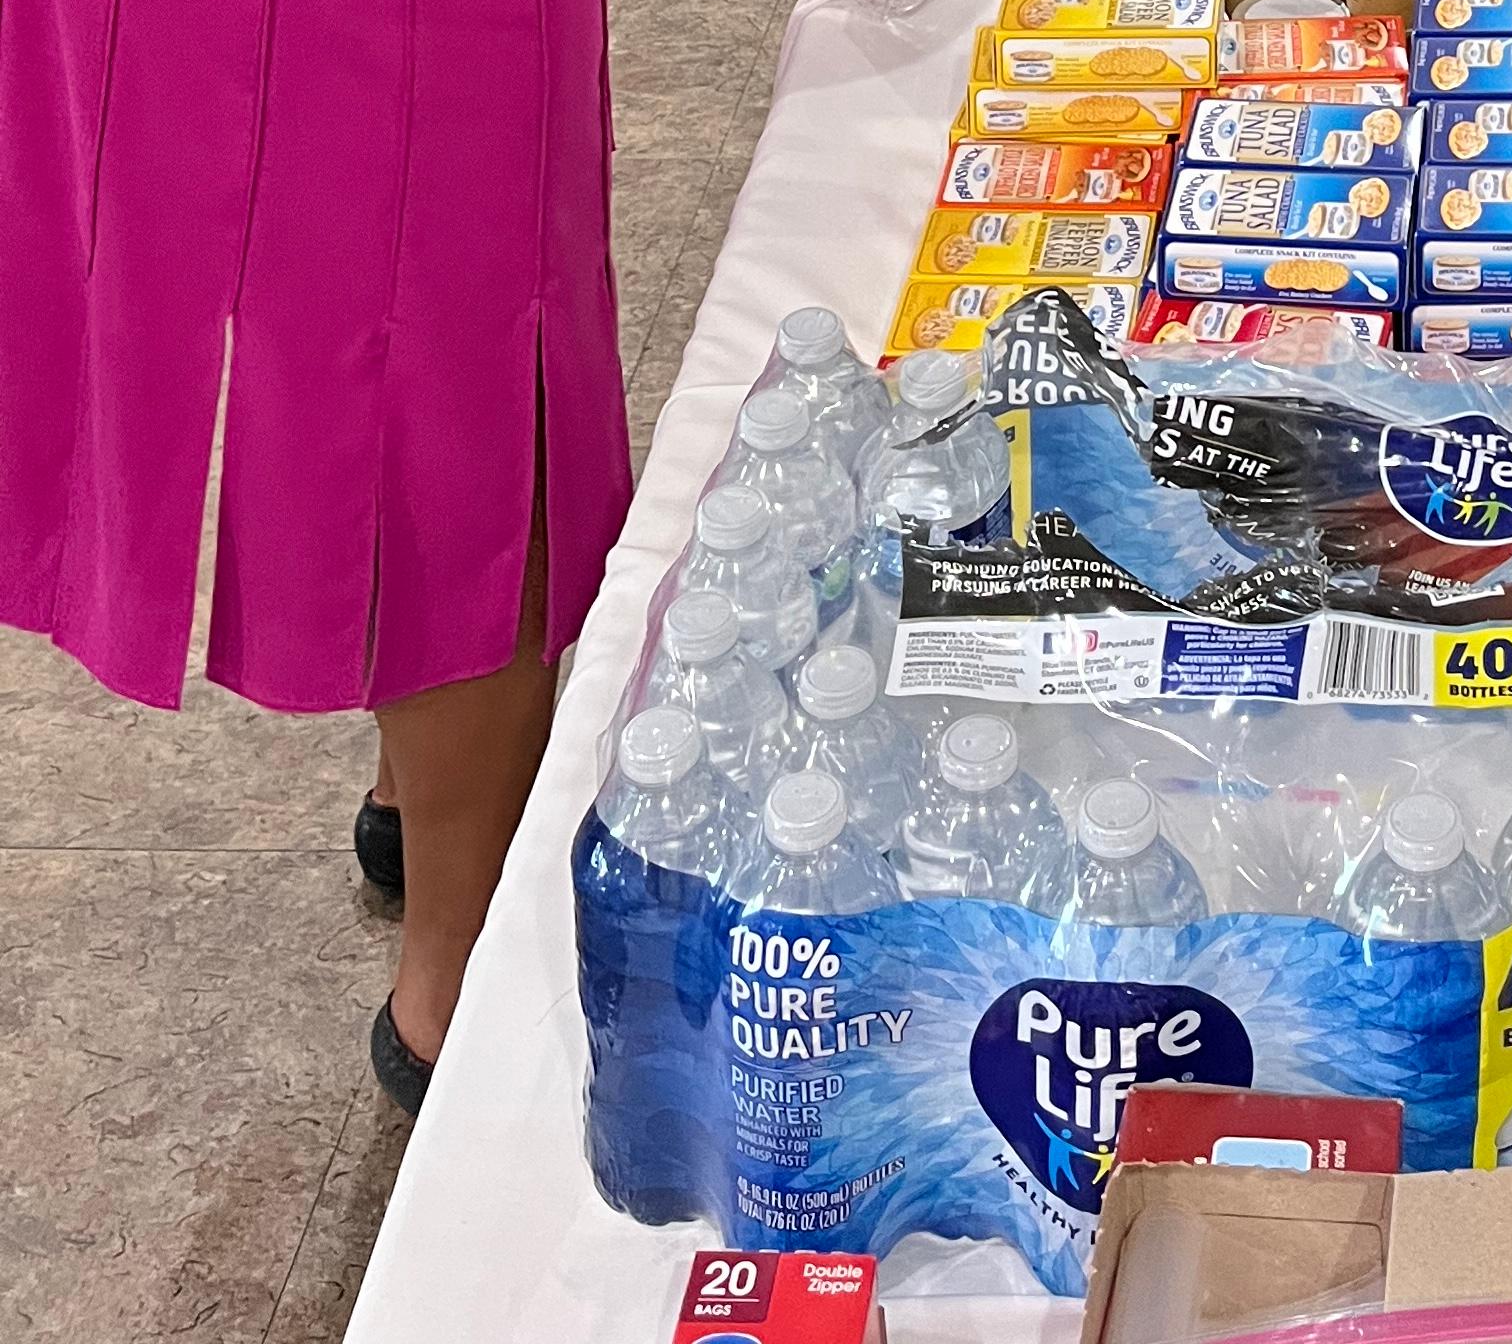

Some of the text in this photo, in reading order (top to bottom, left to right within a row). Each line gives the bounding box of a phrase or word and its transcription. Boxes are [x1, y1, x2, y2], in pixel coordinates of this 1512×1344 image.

[1199, 103, 1232, 158] BRUNSWICK
[1237, 109, 1270, 153] TUNA
[1265, 108, 1296, 158] SALAD
[954, 147, 986, 200] BRUNSWICK
[1178, 173, 1214, 231] BRUNSWICK
[1218, 178, 1253, 226] TUNA
[1247, 177, 1280, 231] SALAD
[1060, 221, 1087, 268] PEPPER
[1080, 221, 1105, 268] LEMON
[1108, 216, 1140, 274] BRUNSWICK
[1276, 249, 1299, 257] SNACK
[1303, 250, 1316, 258] KIT
[1103, 287, 1126, 339] BRUNSW
[1188, 444, 1271, 478] AT THE
[931, 578, 1011, 596] PURSUING
[1096, 577, 1114, 589] IN
[1253, 571, 1275, 586] TO
[1408, 569, 1452, 588] JOIN US
[729, 925, 841, 980] 100%
[729, 972, 838, 1022] PURE
[731, 1009, 912, 1061] QUALITY
[1016, 990, 1202, 1070] Pure
[731, 1064, 844, 1104] PURIFIED
[1036, 1055, 1178, 1141] Lif
[733, 1096, 821, 1125] WATER
[736, 1113, 821, 1137] ENHANCED WITH
[736, 1126, 809, 1153] MINERALS FOR
[736, 1141, 808, 1167] A CRISP TASTE
[771, 1191, 783, 1208] FL
[786, 1193, 800, 1210] OZ
[802, 1192, 828, 1211] (500
[830, 1181, 850, 1205] mL)
[852, 1156, 905, 1195] BOTTLES
[992, 1153, 1080, 1240] HEALTHY
[737, 1193, 850, 1231] TOTAL 676 FL OZ (20 L)
[700, 1261, 757, 1296] 20
[803, 1263, 864, 1279] Double
[807, 1278, 861, 1295] Zipper
[694, 1304, 732, 1316] BAGS
